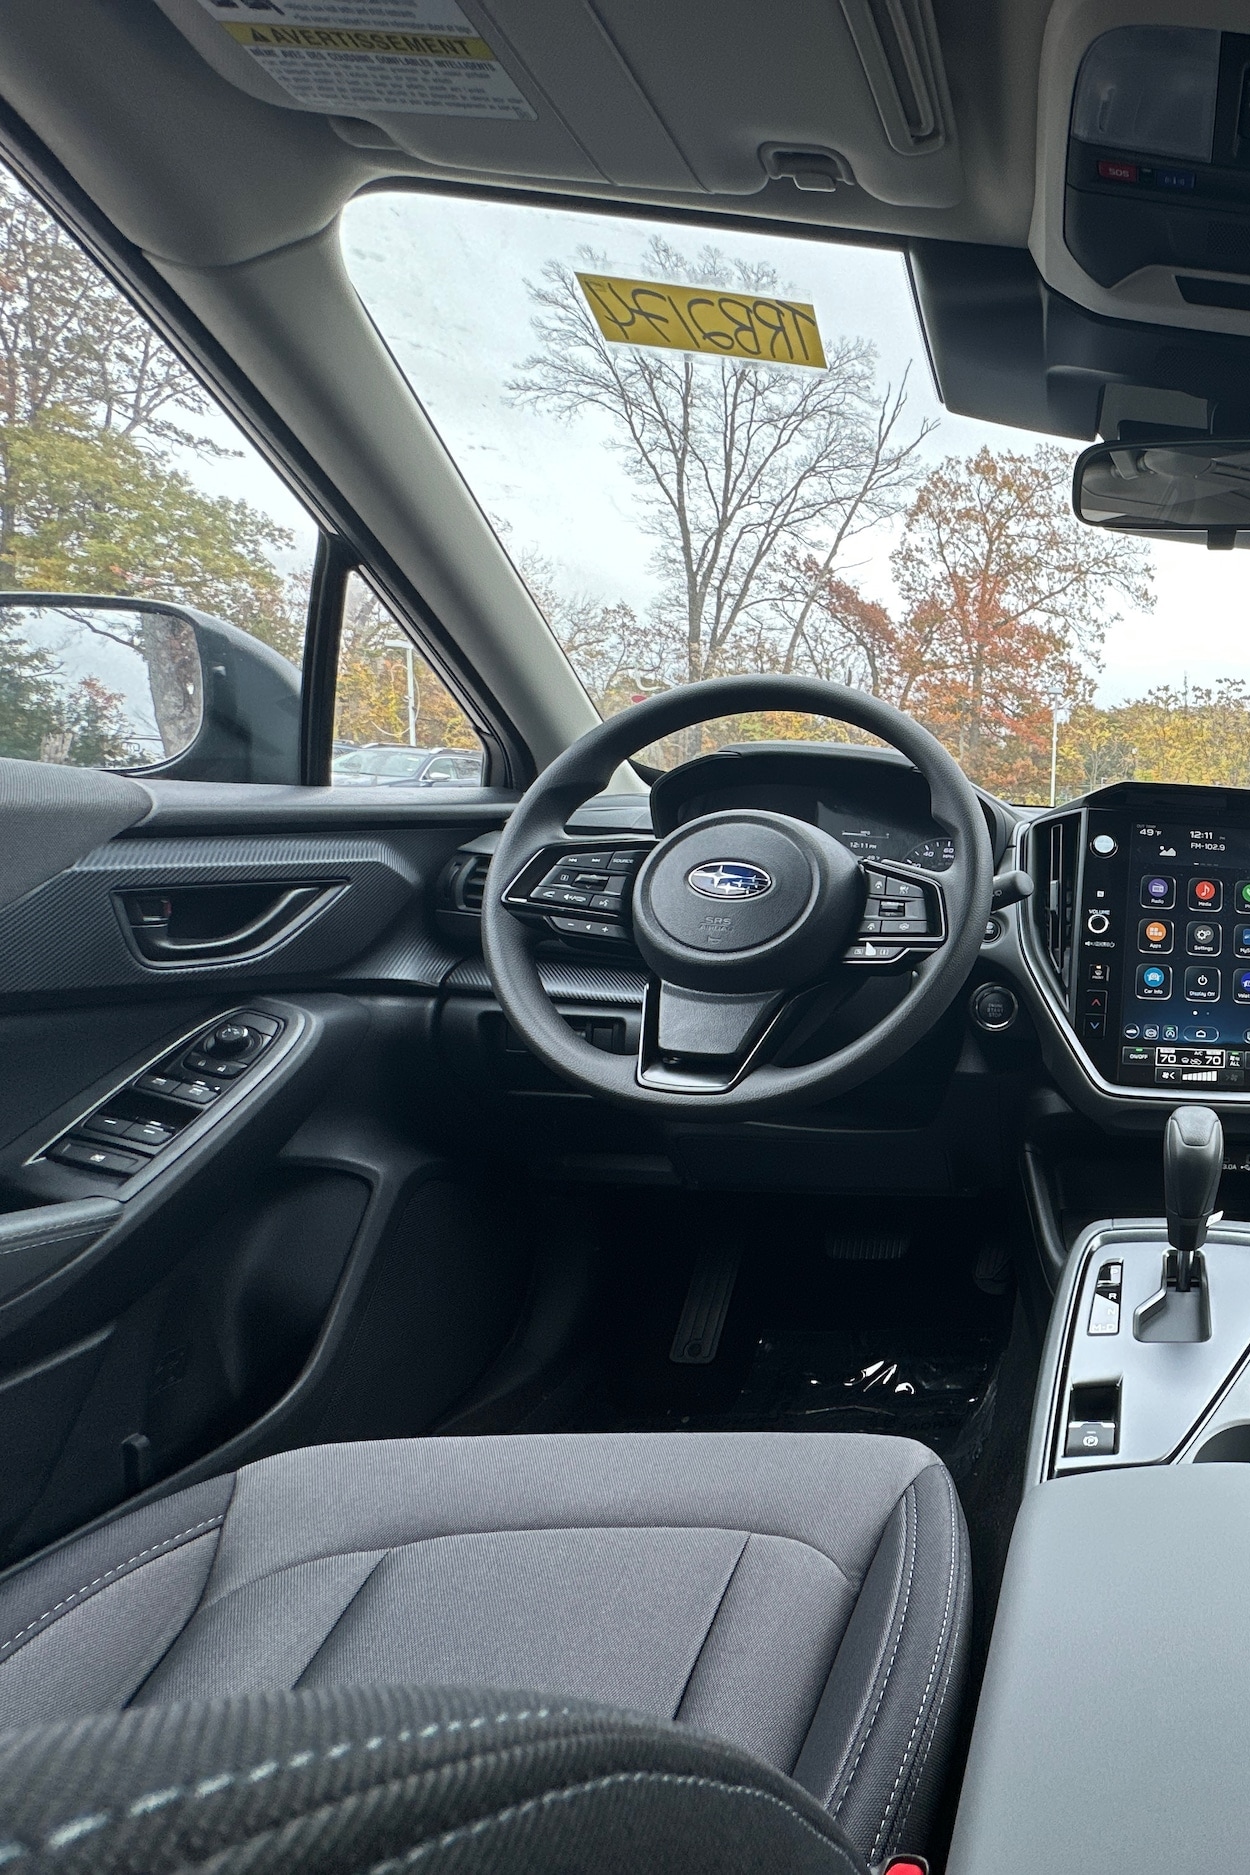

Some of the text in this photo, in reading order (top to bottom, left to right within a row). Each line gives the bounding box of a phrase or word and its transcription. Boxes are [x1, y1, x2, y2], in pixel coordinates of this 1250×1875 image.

[272, 28, 472, 56] AVERTISSEMENT
[1108, 168, 1130, 178] SOS
[1190, 830, 1213, 840] 12:11
[704, 916, 732, 926] SRS
[1160, 1054, 1177, 1063] 70
[1205, 1056, 1222, 1066] 70
